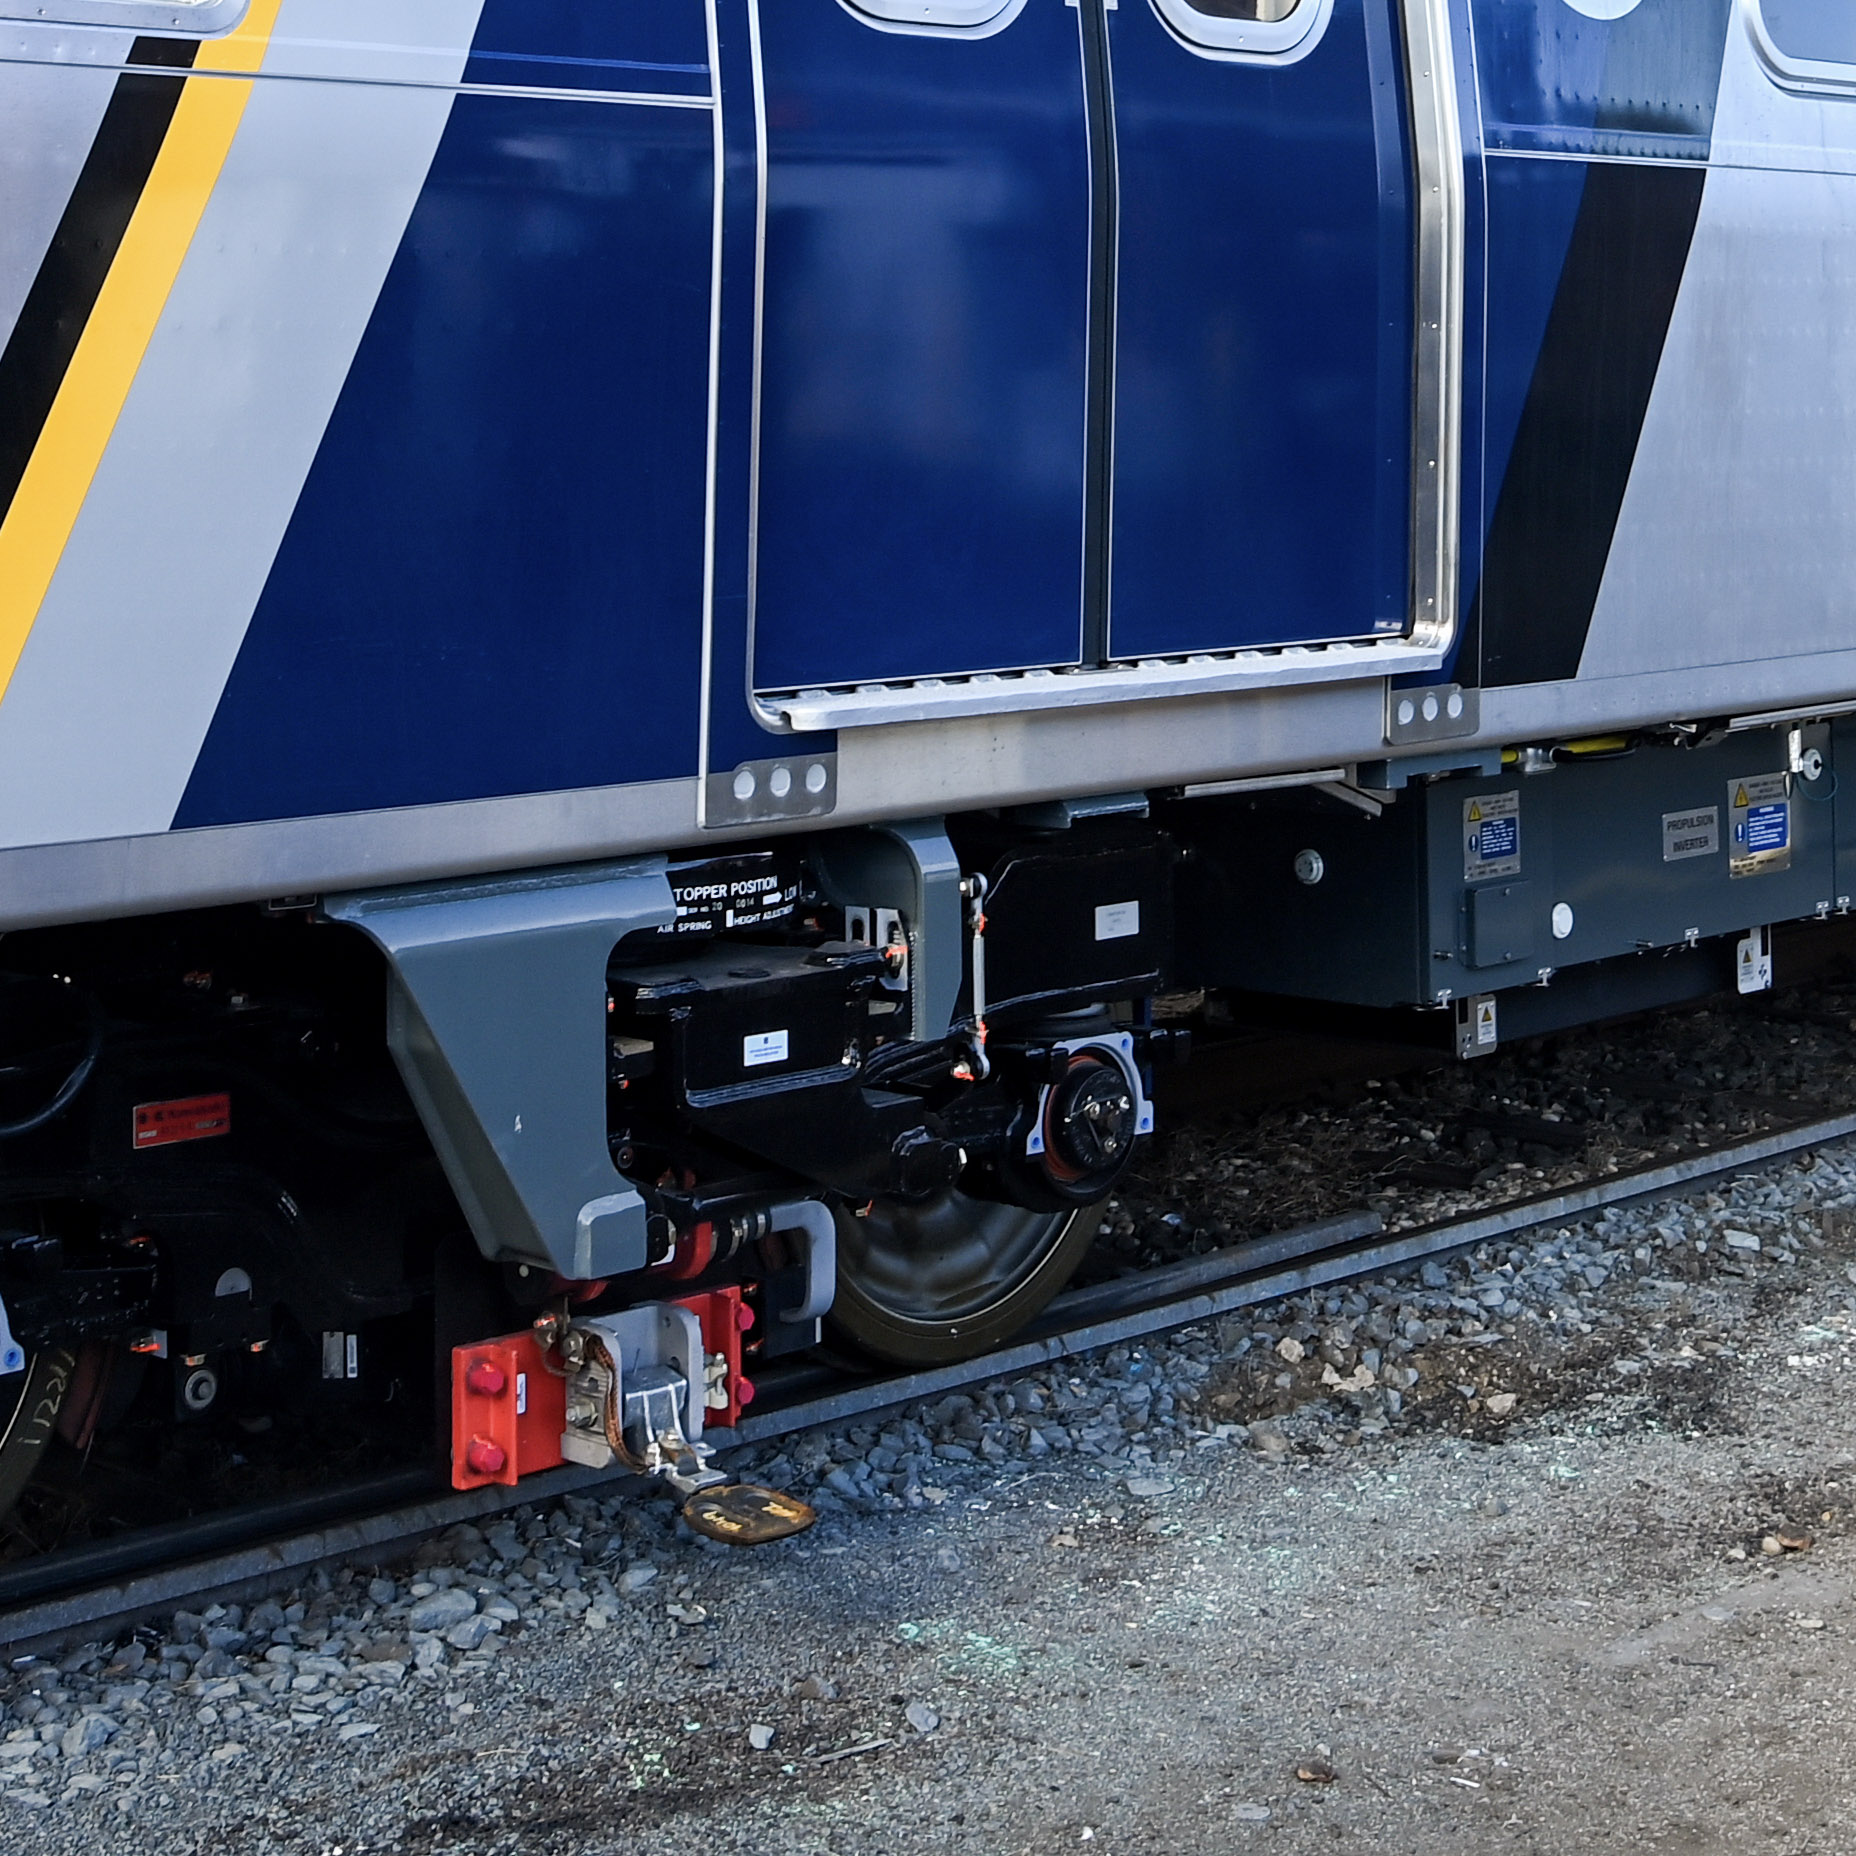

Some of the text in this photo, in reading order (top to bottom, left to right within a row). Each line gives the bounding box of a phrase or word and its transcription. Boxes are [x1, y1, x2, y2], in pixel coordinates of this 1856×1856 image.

[1667, 814, 1714, 831] PROPULSION
[1673, 836, 1709, 853] INVERTER
[730, 875, 778, 897] POSITION
[656, 920, 713, 934] AIR SPRING
[734, 913, 761, 926] HEIGHT
